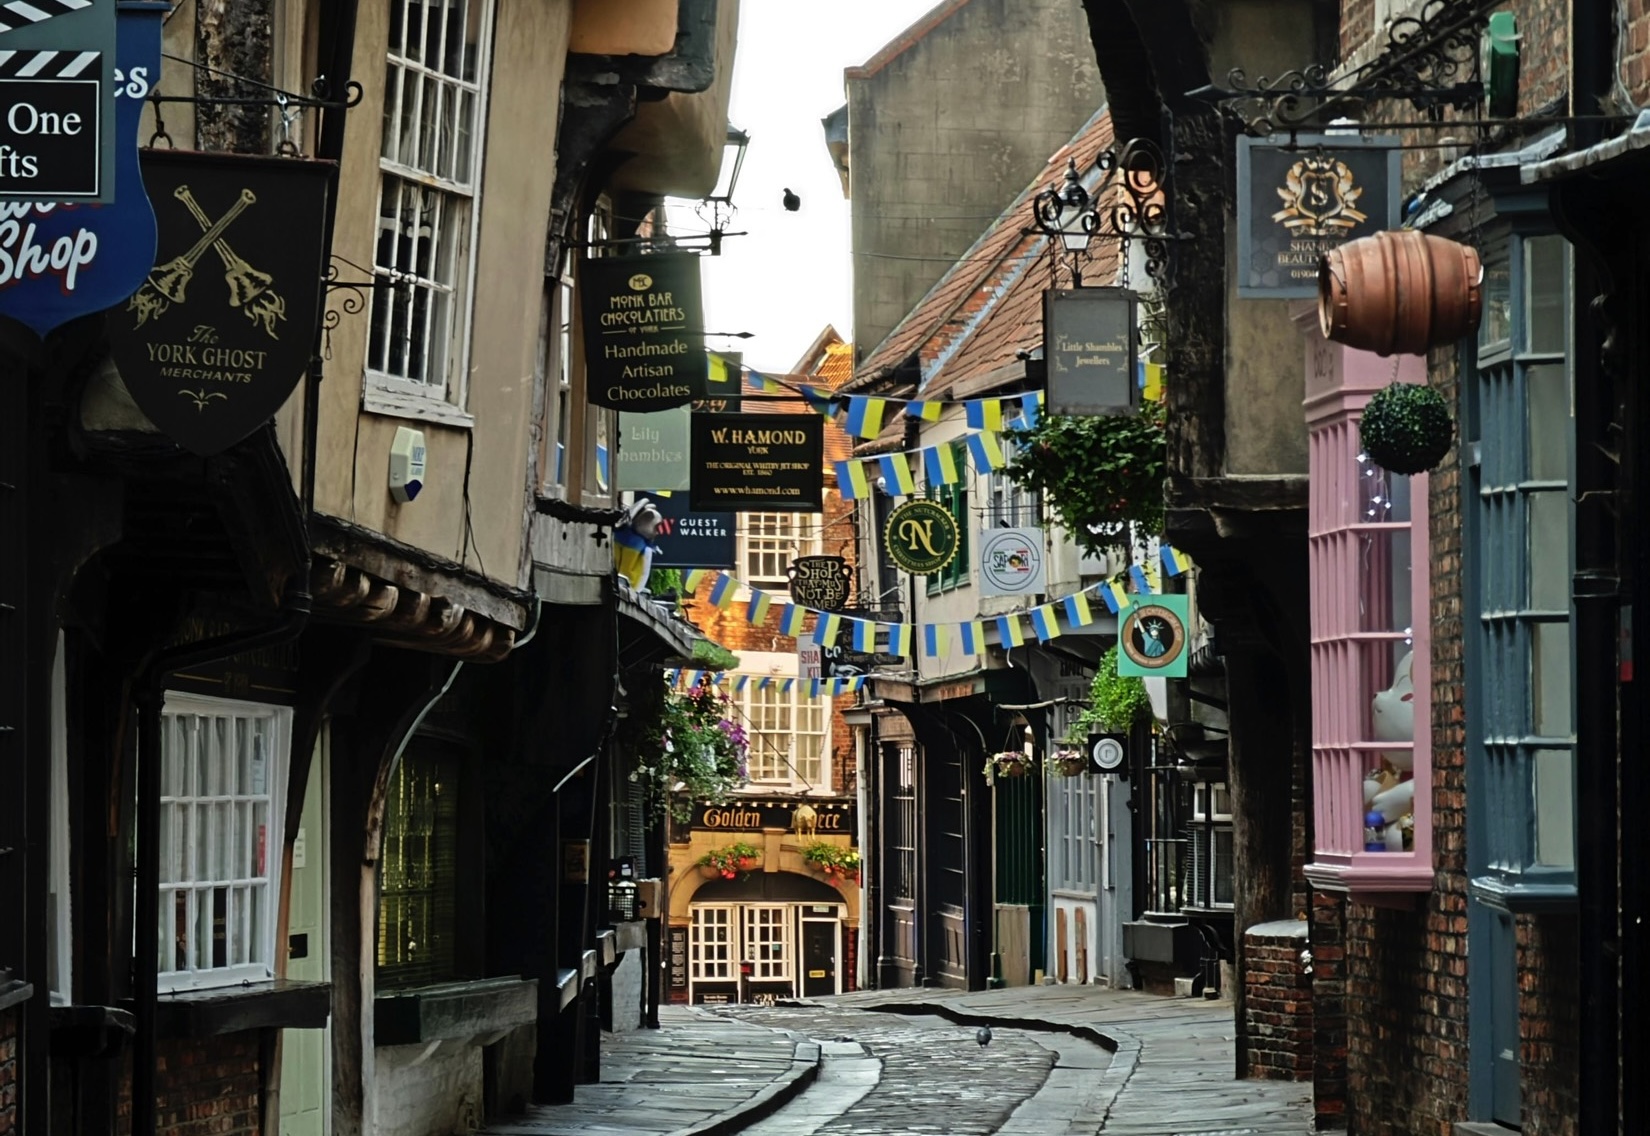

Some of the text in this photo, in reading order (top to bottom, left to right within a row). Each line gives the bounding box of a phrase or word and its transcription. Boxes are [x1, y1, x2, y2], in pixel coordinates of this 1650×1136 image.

[7, 102, 82, 135] One
[610, 292, 673, 310] MONK BAR
[600, 308, 686, 326] CHOCOLATIERS
[187, 325, 219, 344] The
[605, 339, 688, 359] Handmade
[1062, 342, 1122, 351] Little Shambles
[147, 342, 267, 370] YORK GHOST
[1075, 355, 1110, 368] Jewellers
[160, 367, 252, 383] MERCHANTS
[622, 363, 674, 379] Artisan
[607, 382, 691, 401] Chocolates
[631, 426, 660, 444] Lily
[731, 429, 806, 445] HAMOND
[617, 448, 683, 464] hambles
[747, 446, 769, 455] YORK
[679, 518, 718, 527] GUEST
[679, 528, 727, 537] WALKER
[898, 519, 946, 557] N
[798, 560, 840, 579] SHOP
[809, 559, 828, 569] THE
[821, 572, 846, 595] MUST
[795, 585, 844, 601] NOT BE
[703, 807, 761, 828] Golden
